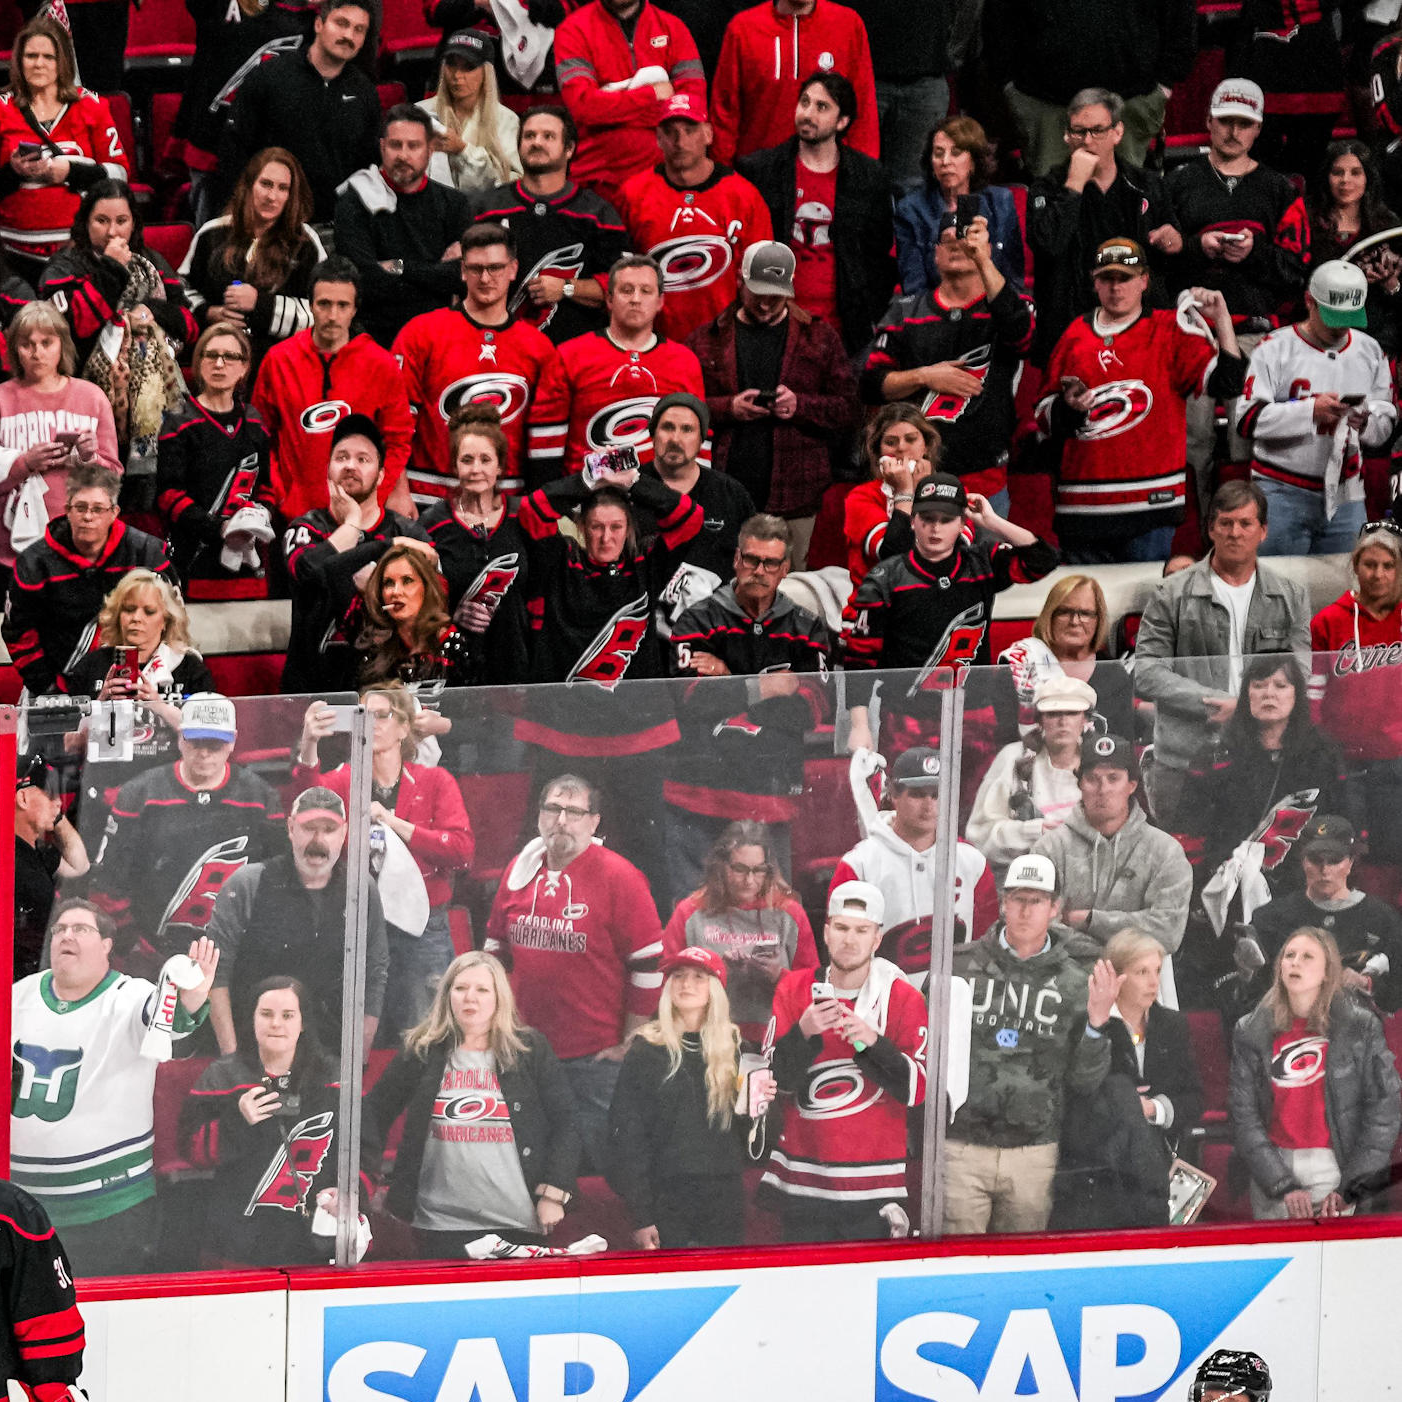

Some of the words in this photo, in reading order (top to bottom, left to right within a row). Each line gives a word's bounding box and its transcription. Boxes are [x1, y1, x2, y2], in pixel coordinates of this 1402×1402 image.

[1334, 640, 1402, 678] Cane
[971, 976, 1063, 1025] UNC
[972, 1015, 1056, 1037] OOTBALL
[918, 1026, 928, 1061] 2
[441, 1067, 501, 1090] AROLIN
[432, 1125, 514, 1143] URRICANES
